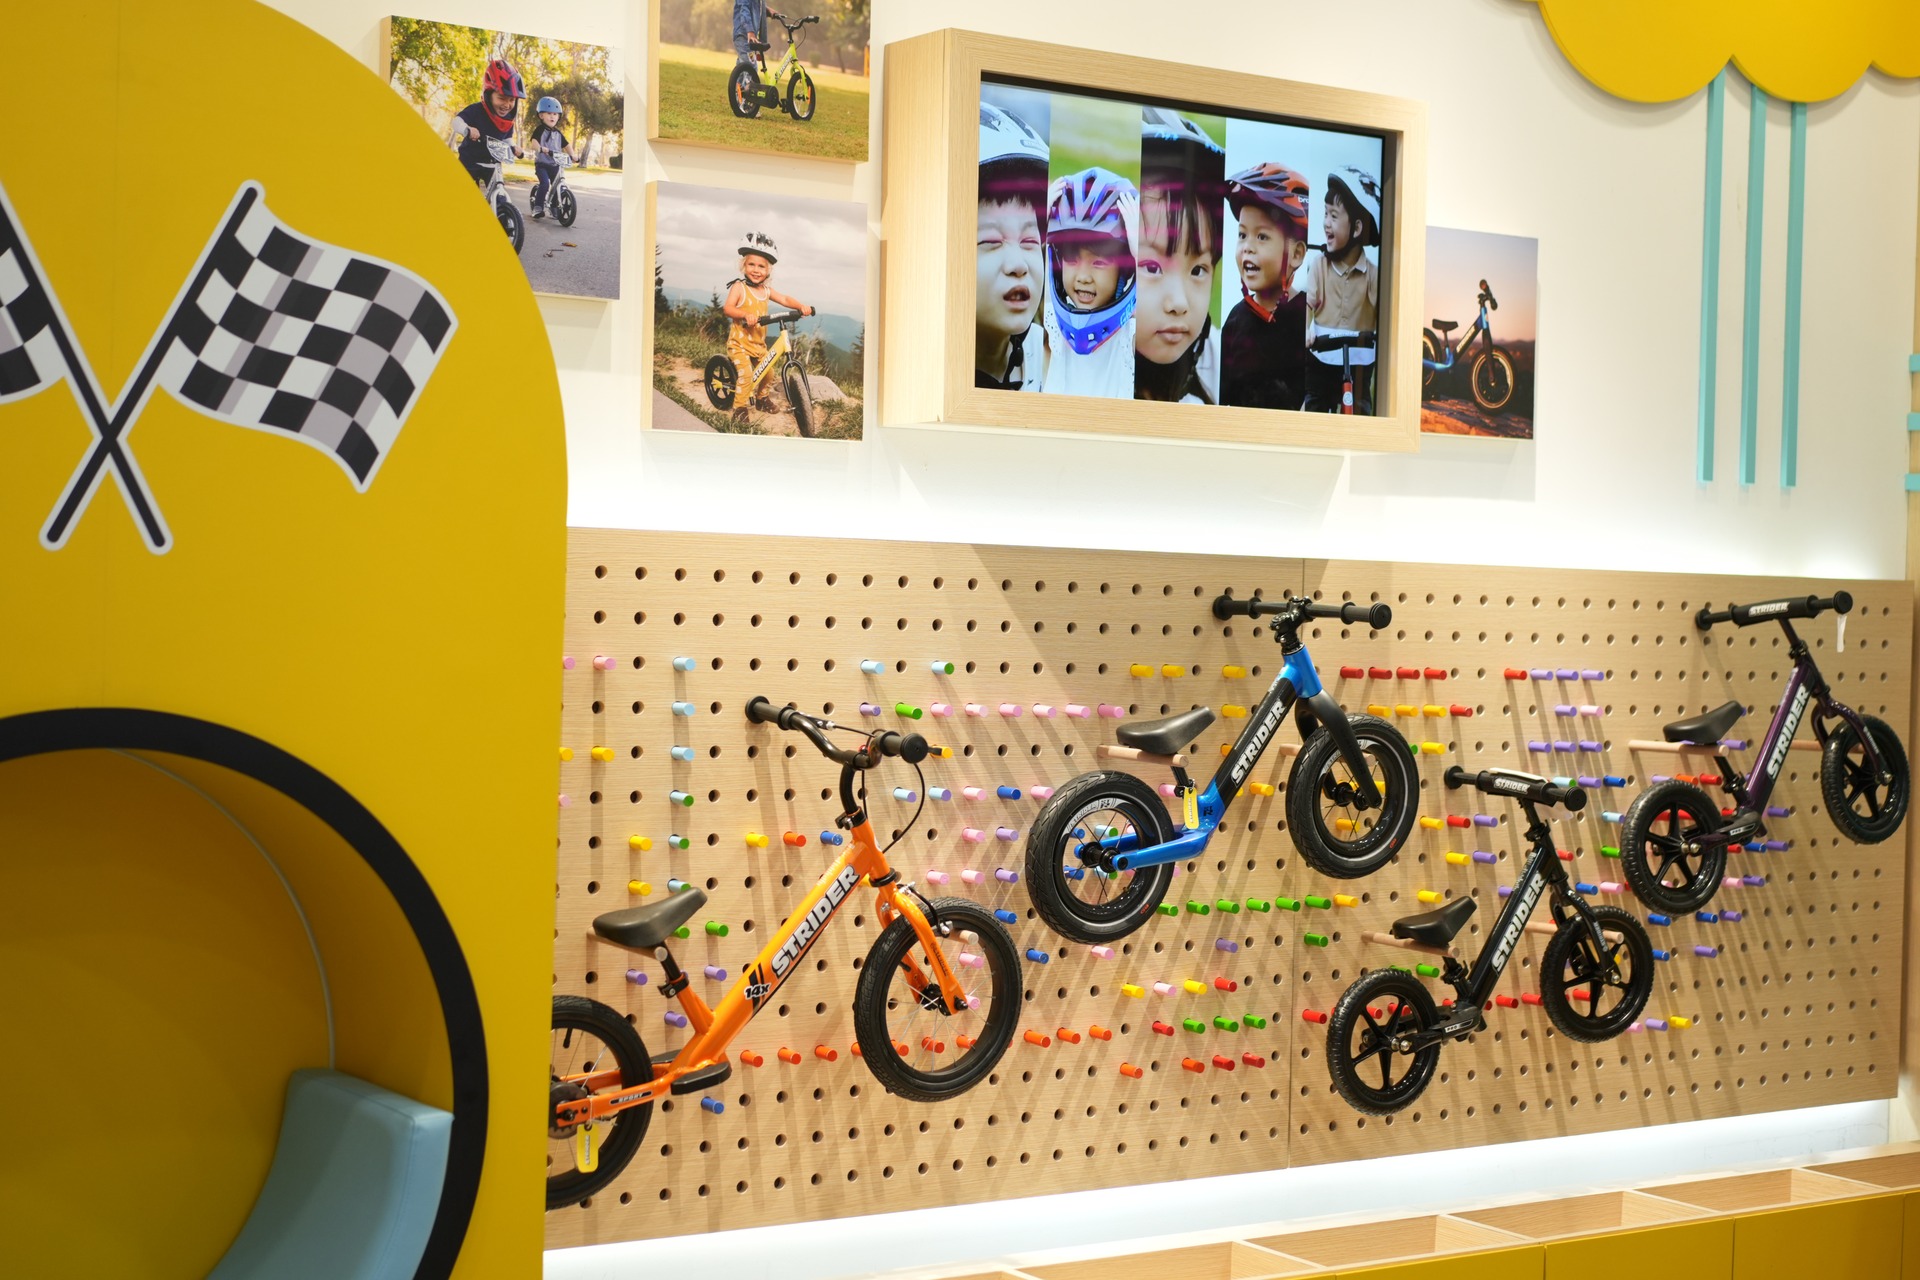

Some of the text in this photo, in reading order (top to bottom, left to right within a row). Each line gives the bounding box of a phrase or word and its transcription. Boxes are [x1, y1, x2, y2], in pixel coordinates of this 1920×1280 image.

[752, 348, 777, 382] STRIDER
[1749, 602, 1789, 616] STRIDER
[1231, 699, 1286, 785] STRIDER
[1766, 683, 1810, 780] STRIDER
[1494, 777, 1530, 794] STRIDER
[771, 865, 860, 978] STRIDER
[1491, 871, 1545, 973] STRIDER
